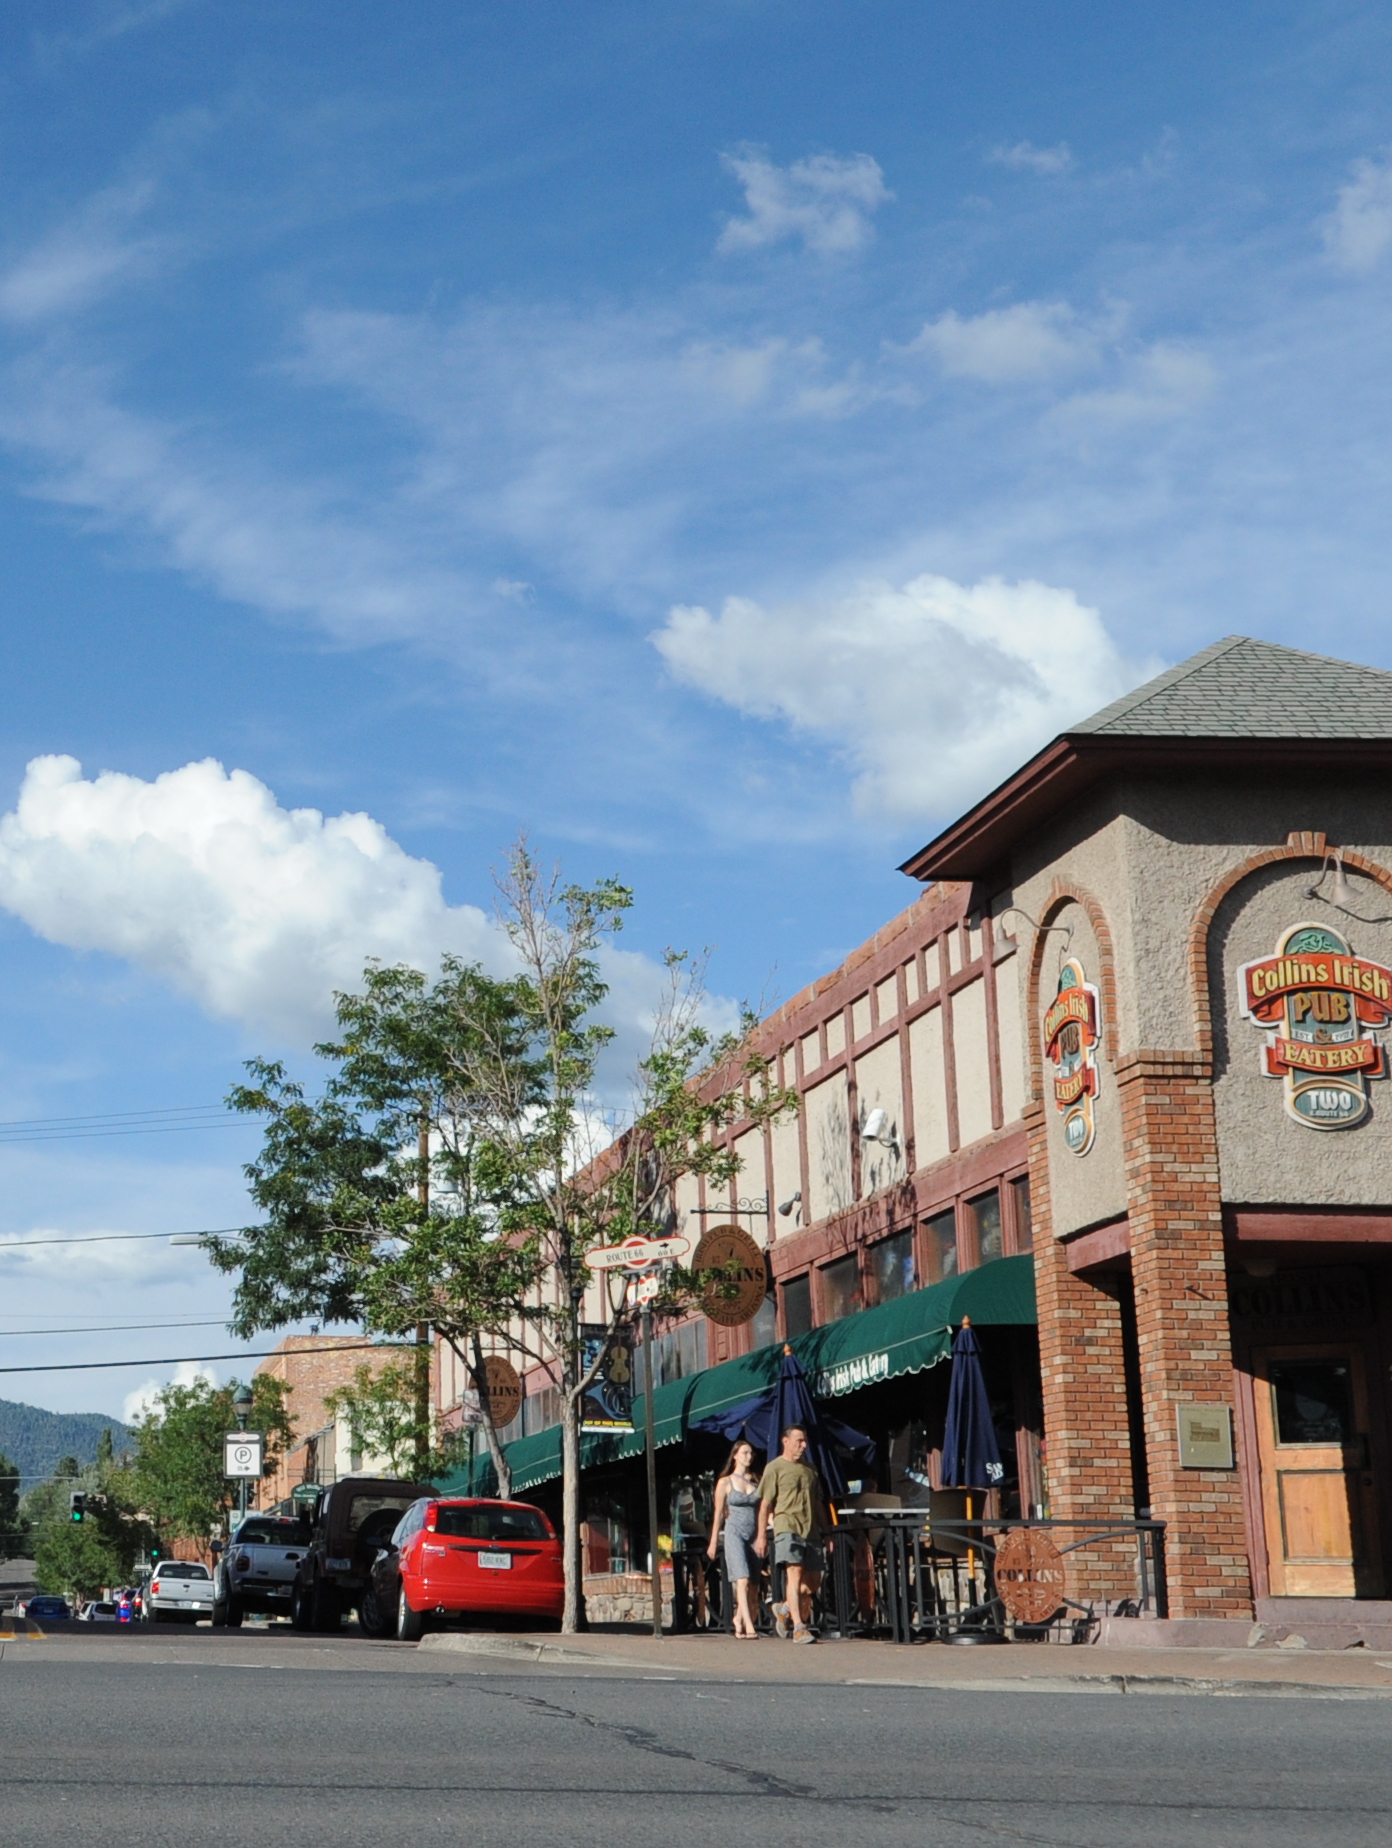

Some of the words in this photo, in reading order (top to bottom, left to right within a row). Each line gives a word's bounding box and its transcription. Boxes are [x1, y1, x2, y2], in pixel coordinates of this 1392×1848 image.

[1251, 959, 1329, 998] Collins
[1332, 959, 1389, 1000] Irish
[1045, 1001, 1068, 1043] Collins
[1069, 992, 1088, 1024] Irish
[1293, 991, 1350, 1022] PUB
[1060, 1025, 1079, 1057] PUB
[1314, 1027, 1335, 1044] &
[1283, 1042, 1368, 1068] EATERY
[1057, 1071, 1083, 1098] EATERY
[1306, 1090, 1352, 1110] TWO
[606, 1250, 633, 1263] ROUTE
[634, 1248, 644, 1259] 66
[1232, 1284, 1366, 1316] COLLINS
[850, 1361, 862, 1384] Pub
[240, 1450, 247, 1460] P
[996, 1568, 1064, 1583] COLLINS
